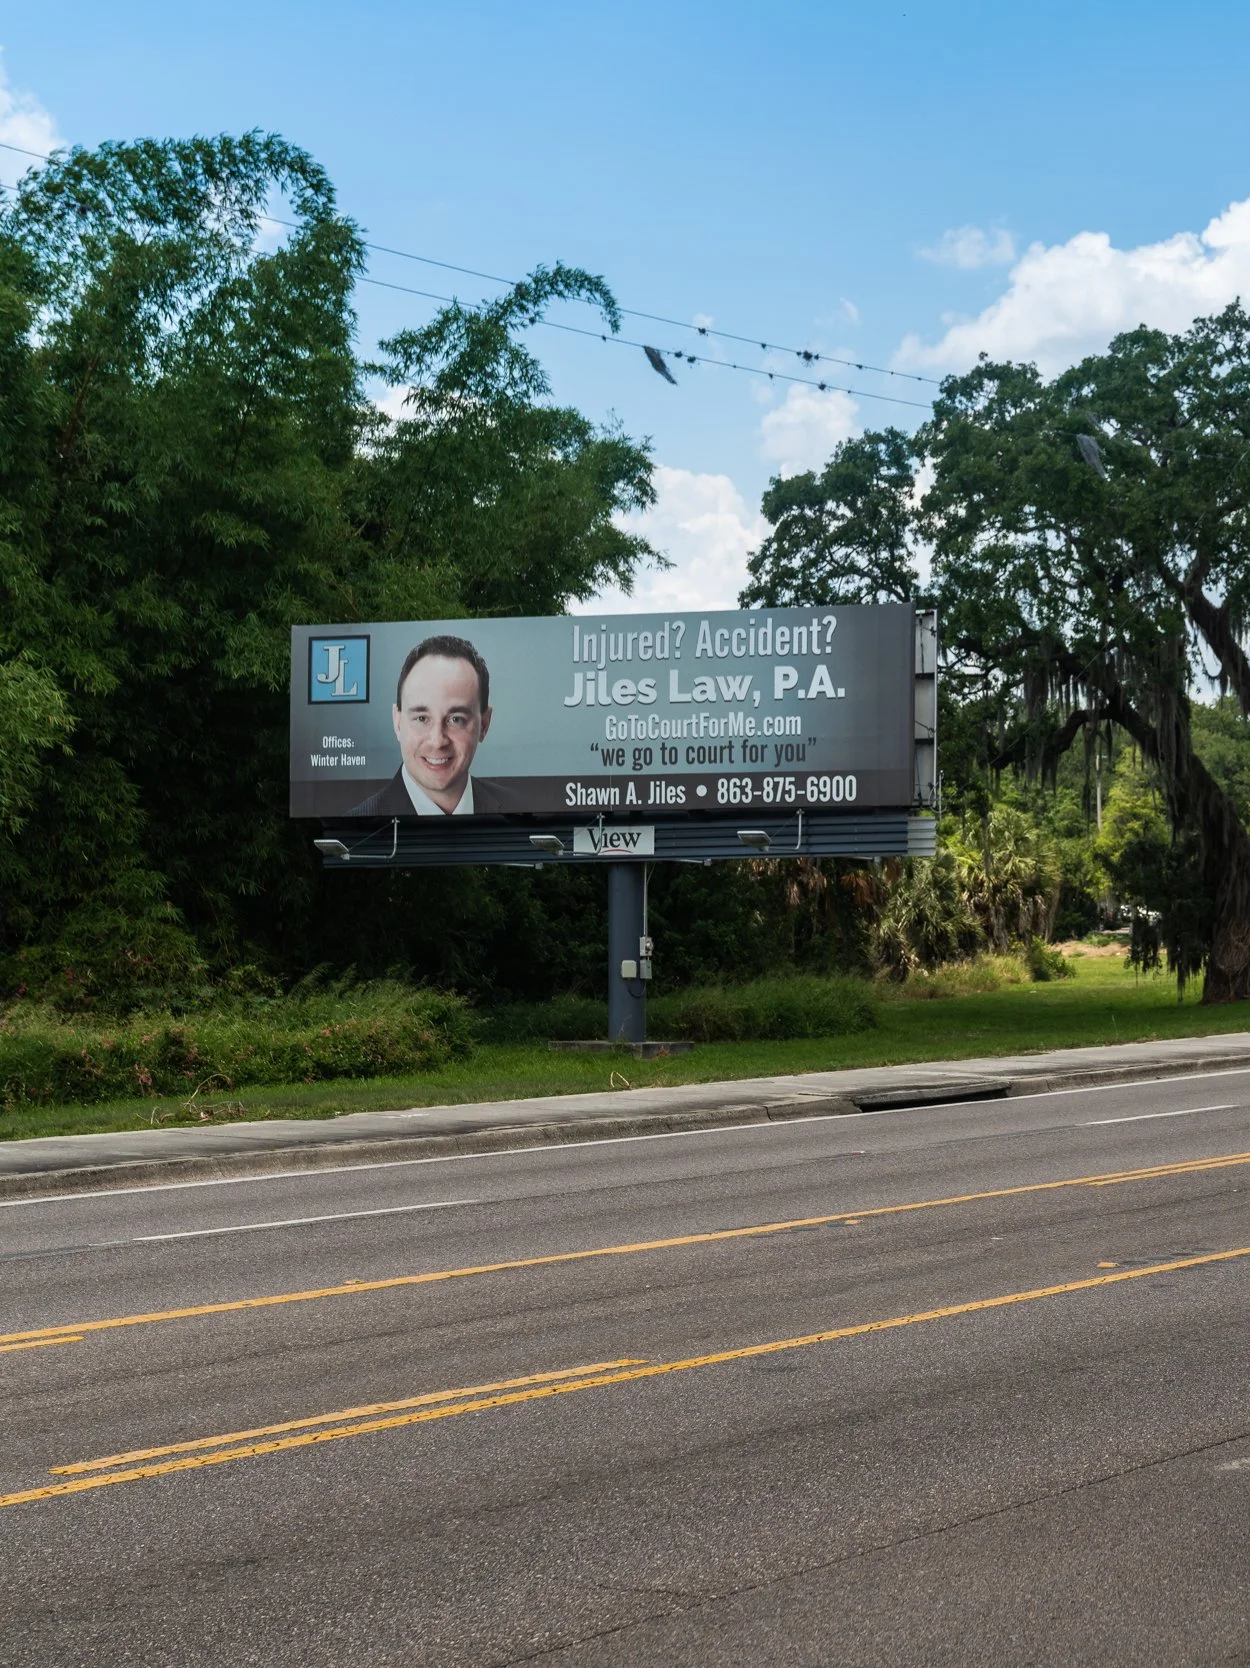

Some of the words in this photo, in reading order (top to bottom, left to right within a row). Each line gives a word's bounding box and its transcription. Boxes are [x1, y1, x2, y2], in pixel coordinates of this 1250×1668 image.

[573, 620, 686, 670] Injured?
[695, 615, 837, 658] Accident?
[316, 645, 359, 696] JL
[563, 670, 658, 707] Jiles
[669, 668, 761, 709] Law,
[773, 664, 846, 700] P.A.
[605, 712, 802, 741] GoToCourtForMe.com
[322, 736, 355, 749] Offices:
[631, 747, 653, 771] go
[660, 742, 679, 766] to
[686, 740, 735, 765] court
[741, 739, 768, 763] for
[310, 754, 339, 767] Winter
[340, 753, 366, 766] Haven
[565, 782, 620, 806] Shawn
[625, 781, 642, 805] A.
[647, 780, 686, 804] Jiles
[717, 775, 857, 804] 863-875-6900
[587, 827, 642, 851] View
